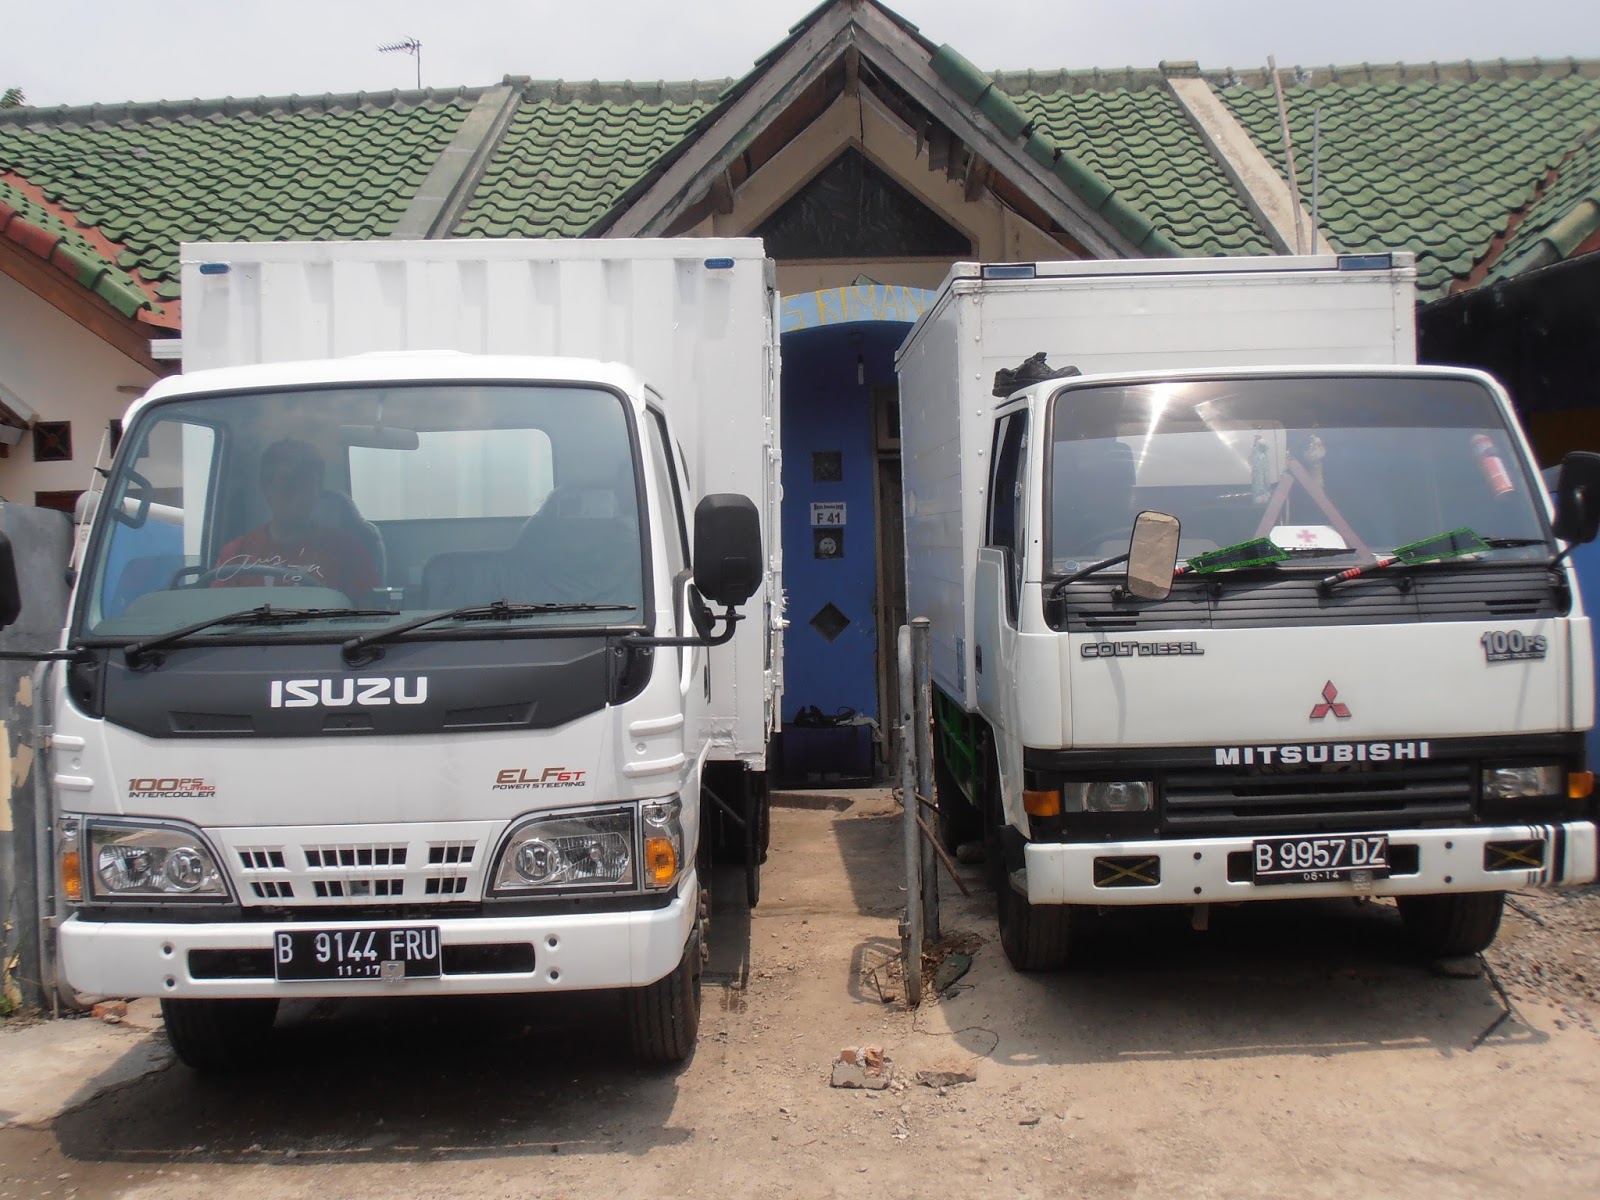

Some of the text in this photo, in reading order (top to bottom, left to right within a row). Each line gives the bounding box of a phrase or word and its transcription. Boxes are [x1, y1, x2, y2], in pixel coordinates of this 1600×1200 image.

[816, 512, 841, 524] F 41
[270, 676, 428, 708] ISUZU
[1215, 741, 1430, 766] MITSUBISHI
[1256, 837, 1386, 871] B 9957 DZ
[278, 929, 437, 963] B 9144 FRU
